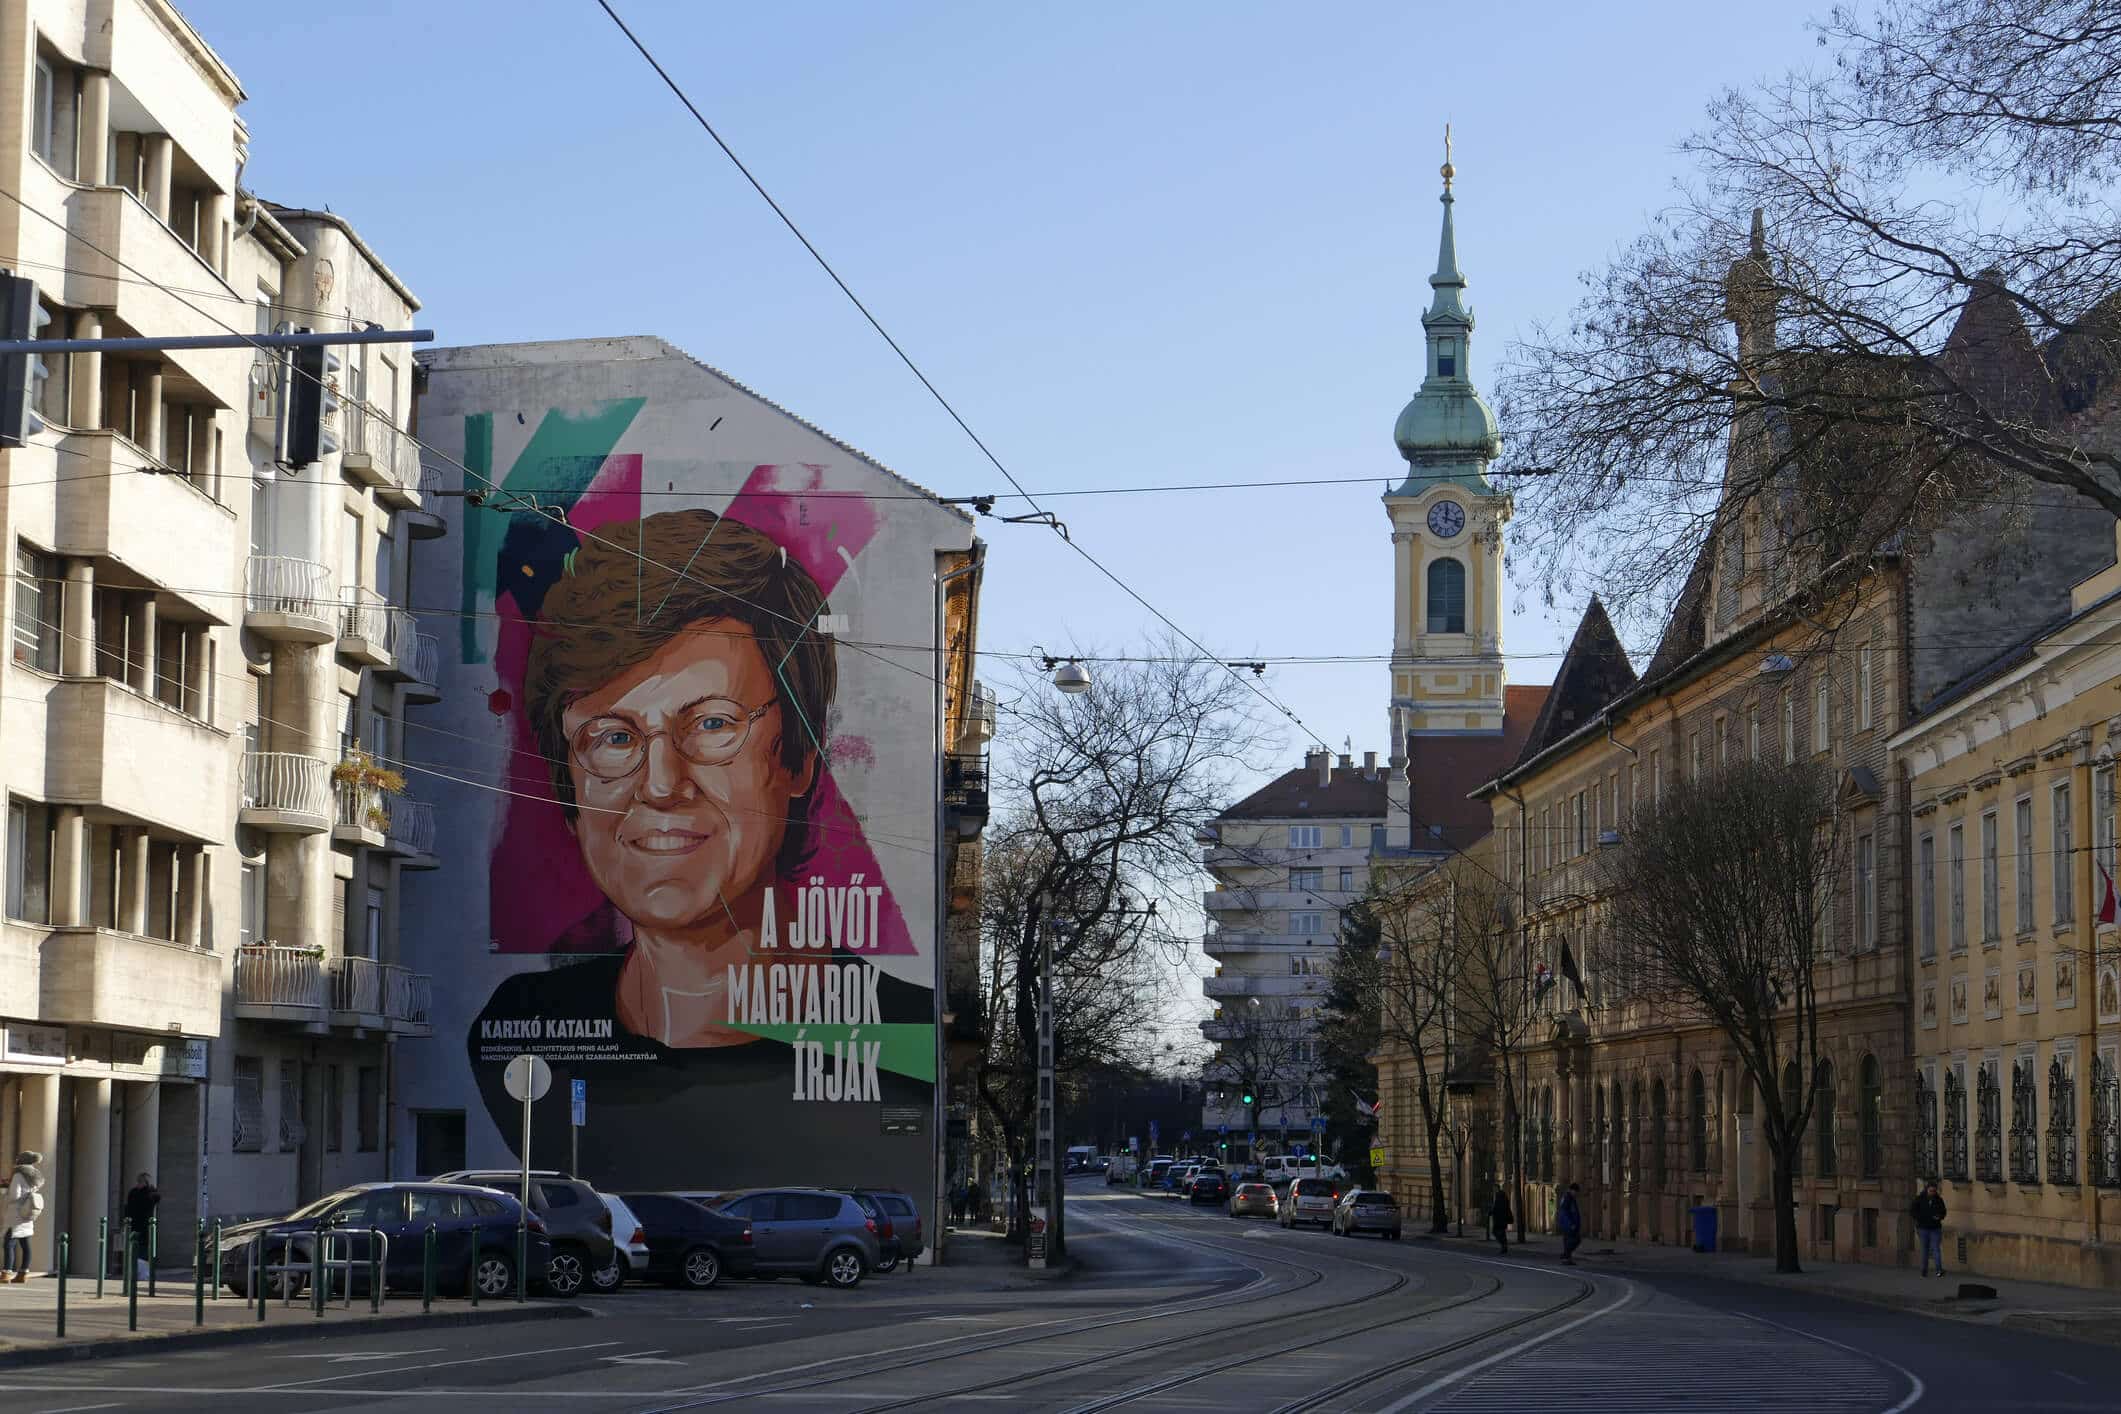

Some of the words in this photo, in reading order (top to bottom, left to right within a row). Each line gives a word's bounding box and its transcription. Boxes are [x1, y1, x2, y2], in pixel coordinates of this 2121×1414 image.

[760, 887, 778, 948] A
[789, 873, 882, 949] JÖVŐT
[481, 1015, 541, 1039] KARIKÓ
[546, 1019, 612, 1039] KATALIN
[727, 963, 882, 1025] MAGYAROK
[793, 1028, 881, 1101] ÍRJÁK
